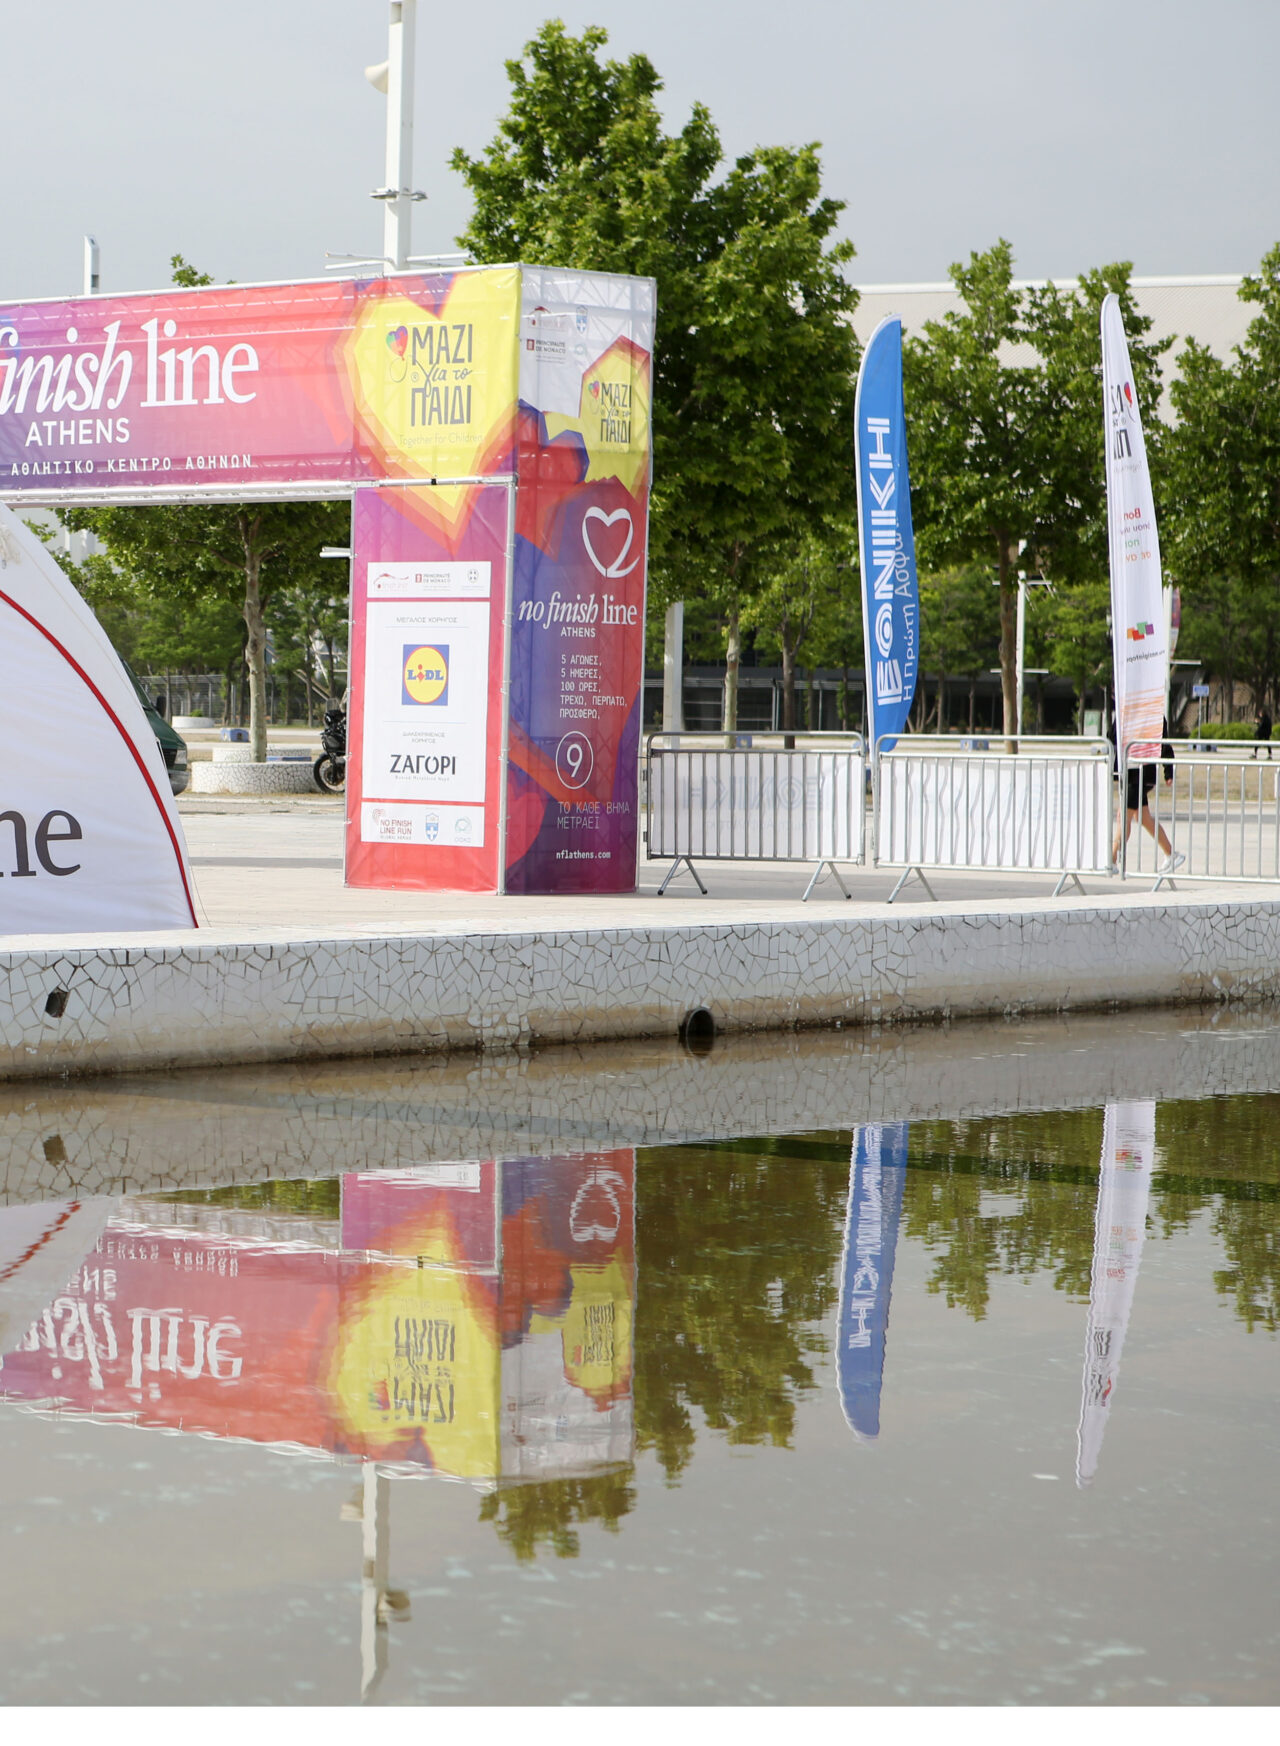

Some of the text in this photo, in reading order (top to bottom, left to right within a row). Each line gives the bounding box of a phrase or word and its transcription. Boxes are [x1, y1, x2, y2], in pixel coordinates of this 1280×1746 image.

[411, 323, 473, 366] ΜΑΖΙ
[140, 316, 260, 410] line
[410, 385, 472, 427] ΠΑΙΔΙ
[600, 382, 632, 408] ΜΑΖΙ
[24, 417, 130, 447] ATHENS
[600, 419, 631, 444] ΠΑΙΔΙ
[11, 459, 95, 476] ΑΘΛΗΤΙΚΟ
[107, 457, 172, 473] ΚΕΝΤΡΟ
[185, 454, 252, 470] ΑΘΗΝΩΝ
[518, 591, 638, 630] no finish line
[560, 626, 596, 638] ATHENS
[561, 654, 566, 664] 5
[561, 668, 566, 678] 5
[560, 681, 575, 692] 100
[389, 753, 456, 775] ΖΑΓΟΡΙ
[566, 743, 583, 778] 9
[557, 801, 631, 815] ΤΟ ΚΑΘΕ ΒΗΜΑ
[557, 816, 601, 830] ΜΕΤΡΑΕΙ
[555, 849, 611, 860] nflathens.com
